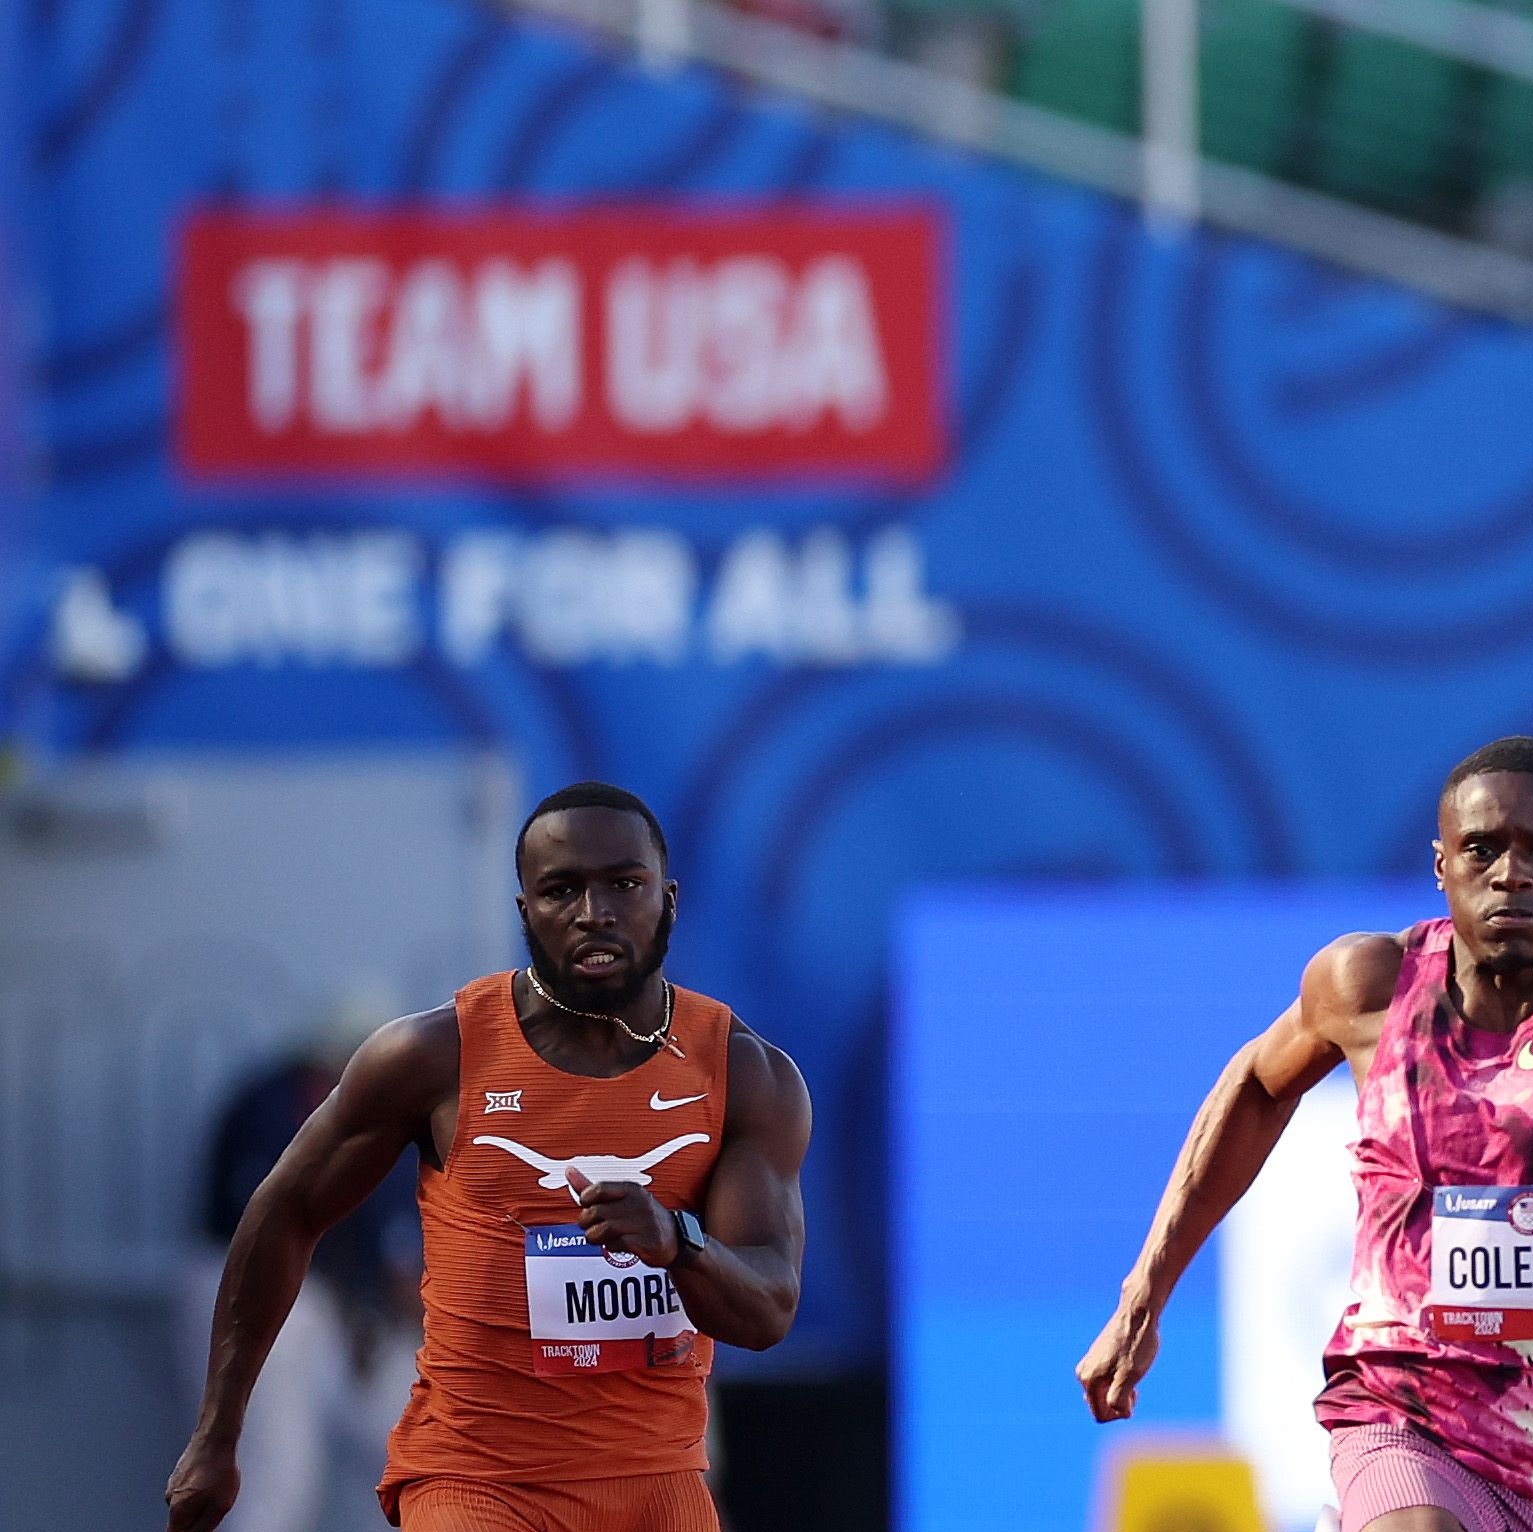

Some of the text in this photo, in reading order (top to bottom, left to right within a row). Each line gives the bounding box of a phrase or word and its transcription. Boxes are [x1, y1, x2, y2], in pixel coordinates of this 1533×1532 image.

[236, 255, 889, 432] TEAM USA
[166, 528, 957, 667] ONE FOR ALL
[565, 1272, 680, 1324] MOORE
[541, 1343, 600, 1358] TRACKTOWN
[573, 1354, 598, 1367] 2024
